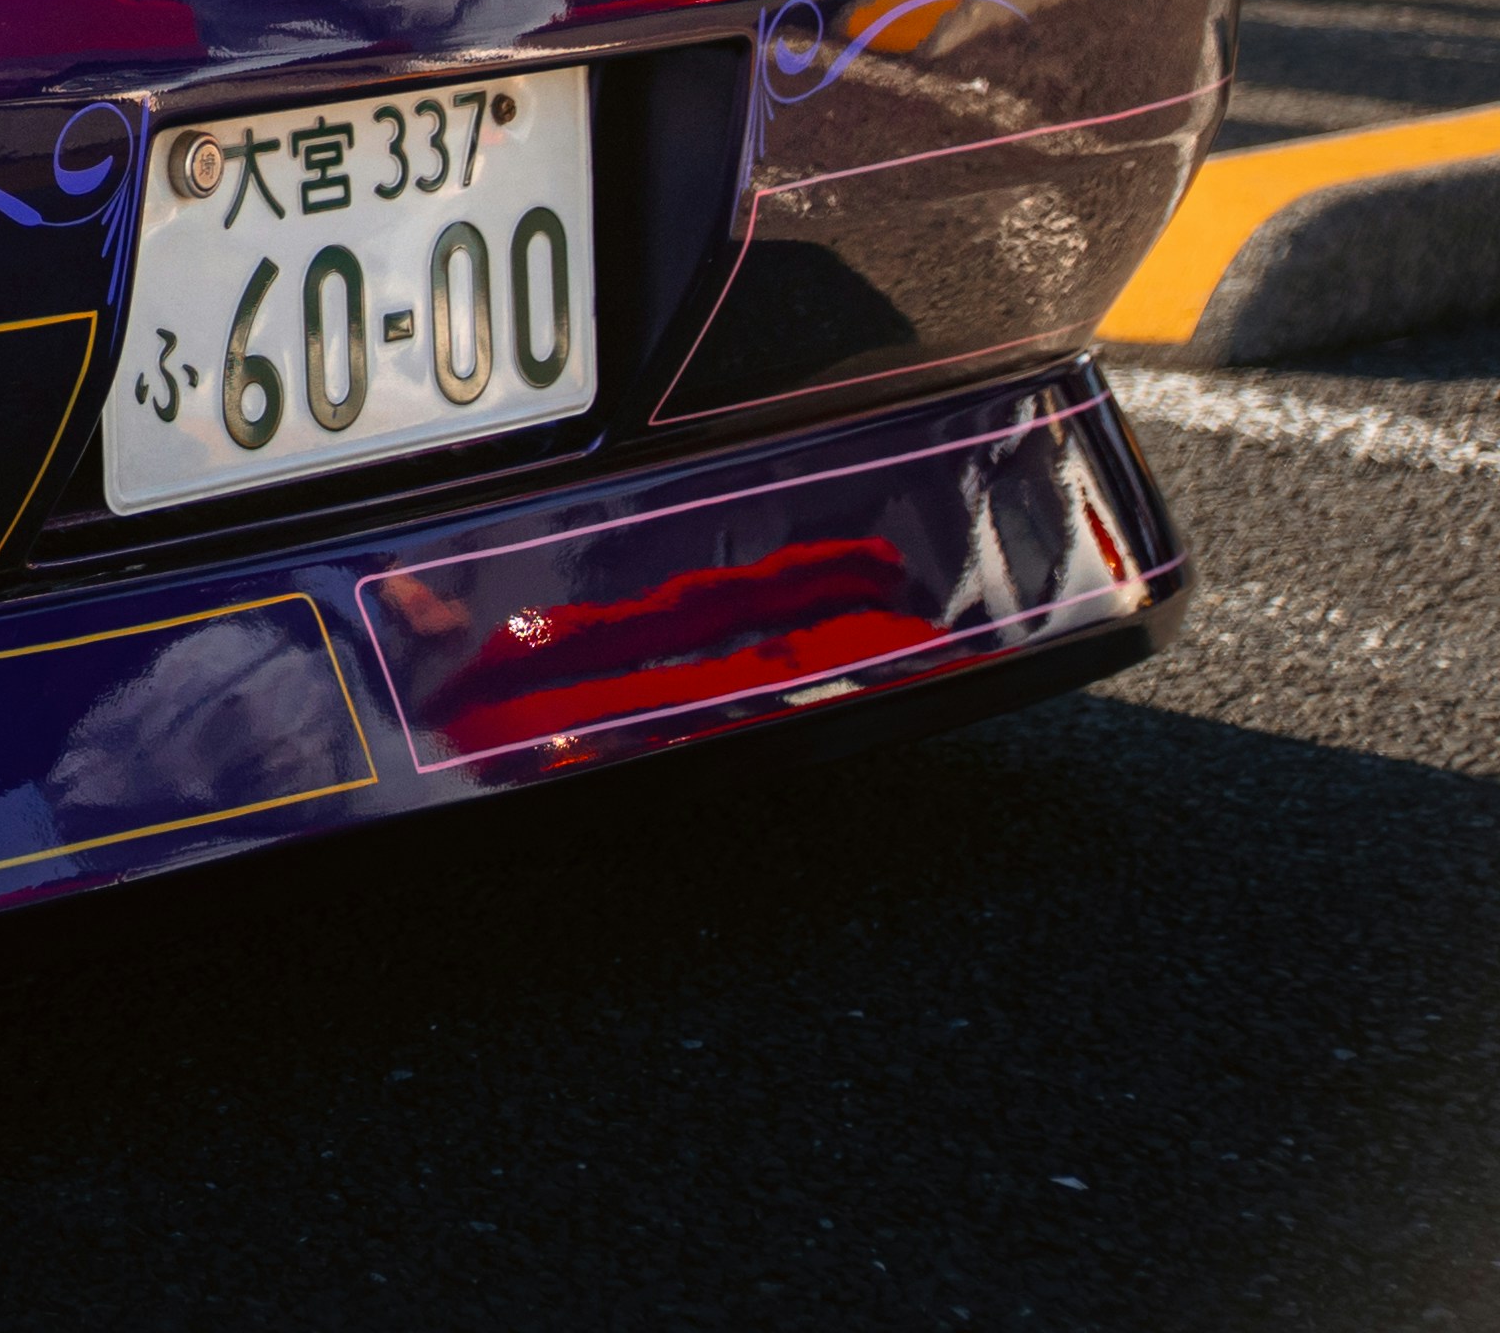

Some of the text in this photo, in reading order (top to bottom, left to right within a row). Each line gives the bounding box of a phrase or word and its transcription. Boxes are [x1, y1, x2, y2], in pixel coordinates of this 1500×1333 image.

[222, 90, 488, 230] 大宮 337
[134, 205, 572, 451] ふ 60-00
